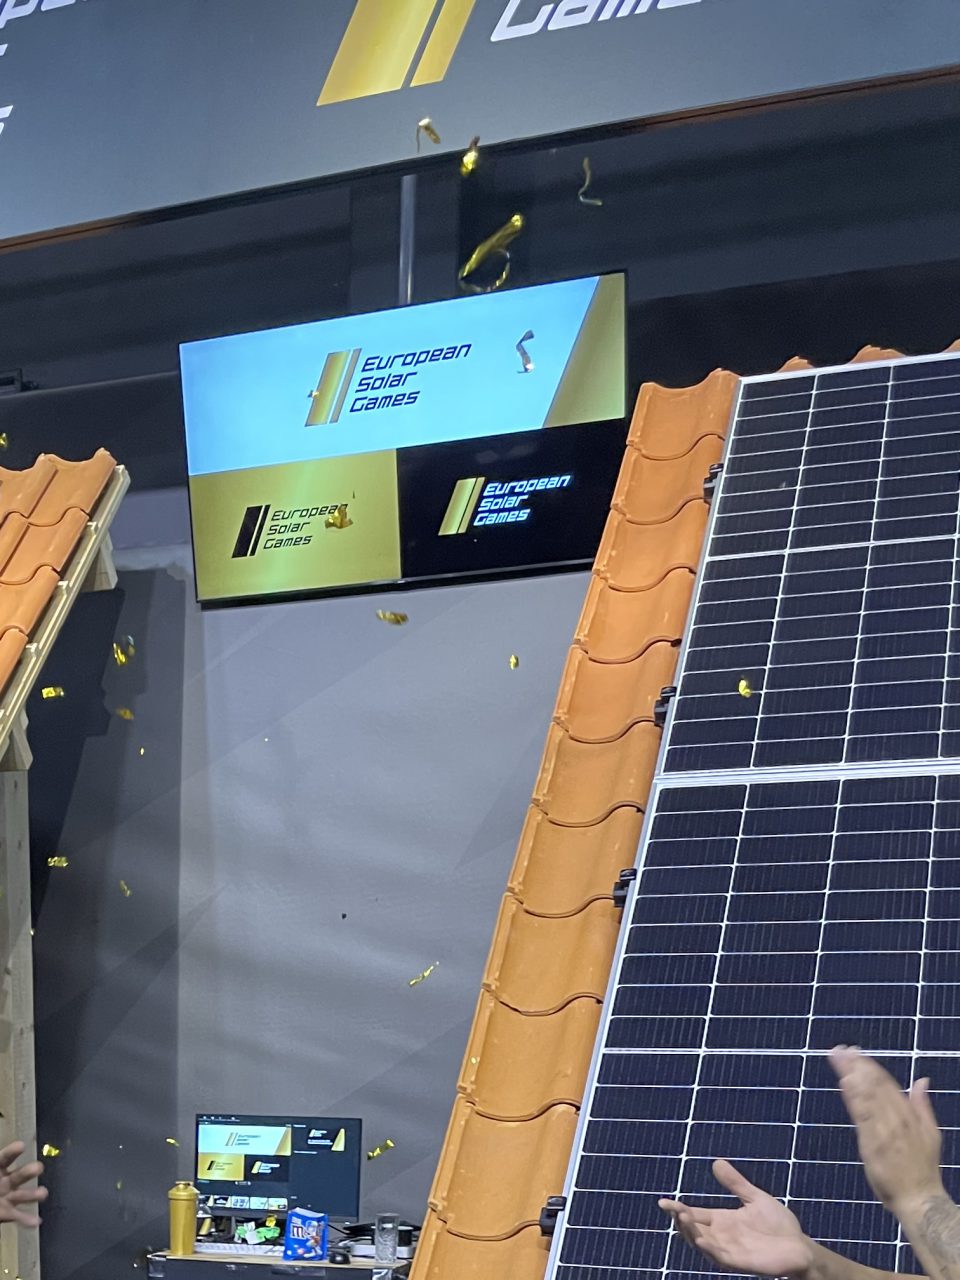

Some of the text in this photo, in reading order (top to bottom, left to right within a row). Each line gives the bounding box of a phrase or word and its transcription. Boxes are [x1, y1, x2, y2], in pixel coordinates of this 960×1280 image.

[361, 344, 472, 373] European
[355, 372, 418, 393] Solar
[349, 391, 420, 413] Games
[483, 475, 571, 496] European
[477, 494, 529, 511] Solar
[473, 508, 531, 526] Games
[267, 522, 311, 535] Solar
[263, 535, 313, 549] Games
